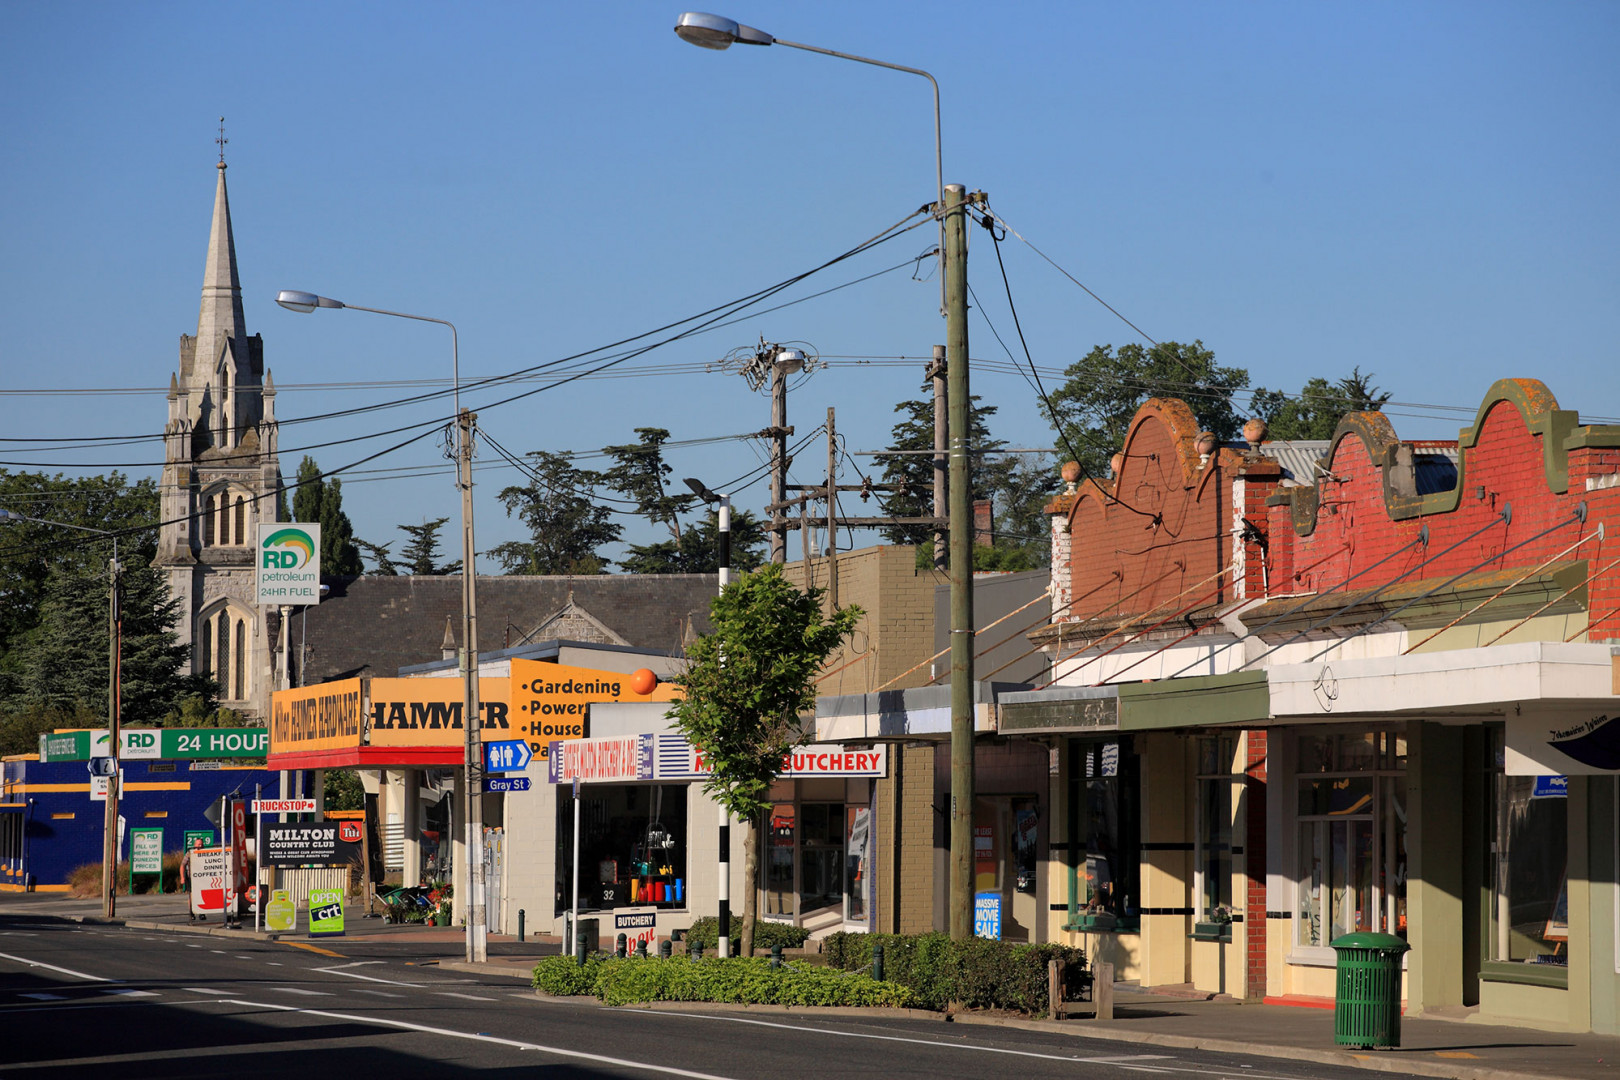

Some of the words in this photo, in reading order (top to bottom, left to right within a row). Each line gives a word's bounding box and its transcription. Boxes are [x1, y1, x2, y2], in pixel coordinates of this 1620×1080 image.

[263, 551, 298, 569] RD
[262, 572, 316, 584] petroleum
[261, 588, 287, 596] 24HR
[290, 588, 315, 596] FUEL
[531, 679, 621, 696] Gardening
[318, 691, 358, 738] HARDWARE
[127, 733, 155, 748] RD
[177, 735, 201, 751] 24
[780, 753, 881, 771] BUTCHERY
[490, 780, 512, 792] Gray
[513, 779, 524, 790] St
[253, 801, 307, 811] TRUCKSTOP
[269, 829, 336, 840] MILTON
[311, 892, 341, 904] OPEN
[603, 890, 614, 900] 32
[975, 899, 999, 909] MASSIVE
[318, 905, 341, 920] crt
[975, 910, 999, 921] MOVIE
[617, 915, 654, 926] BUTCHERY
[975, 922, 999, 939] SALE
